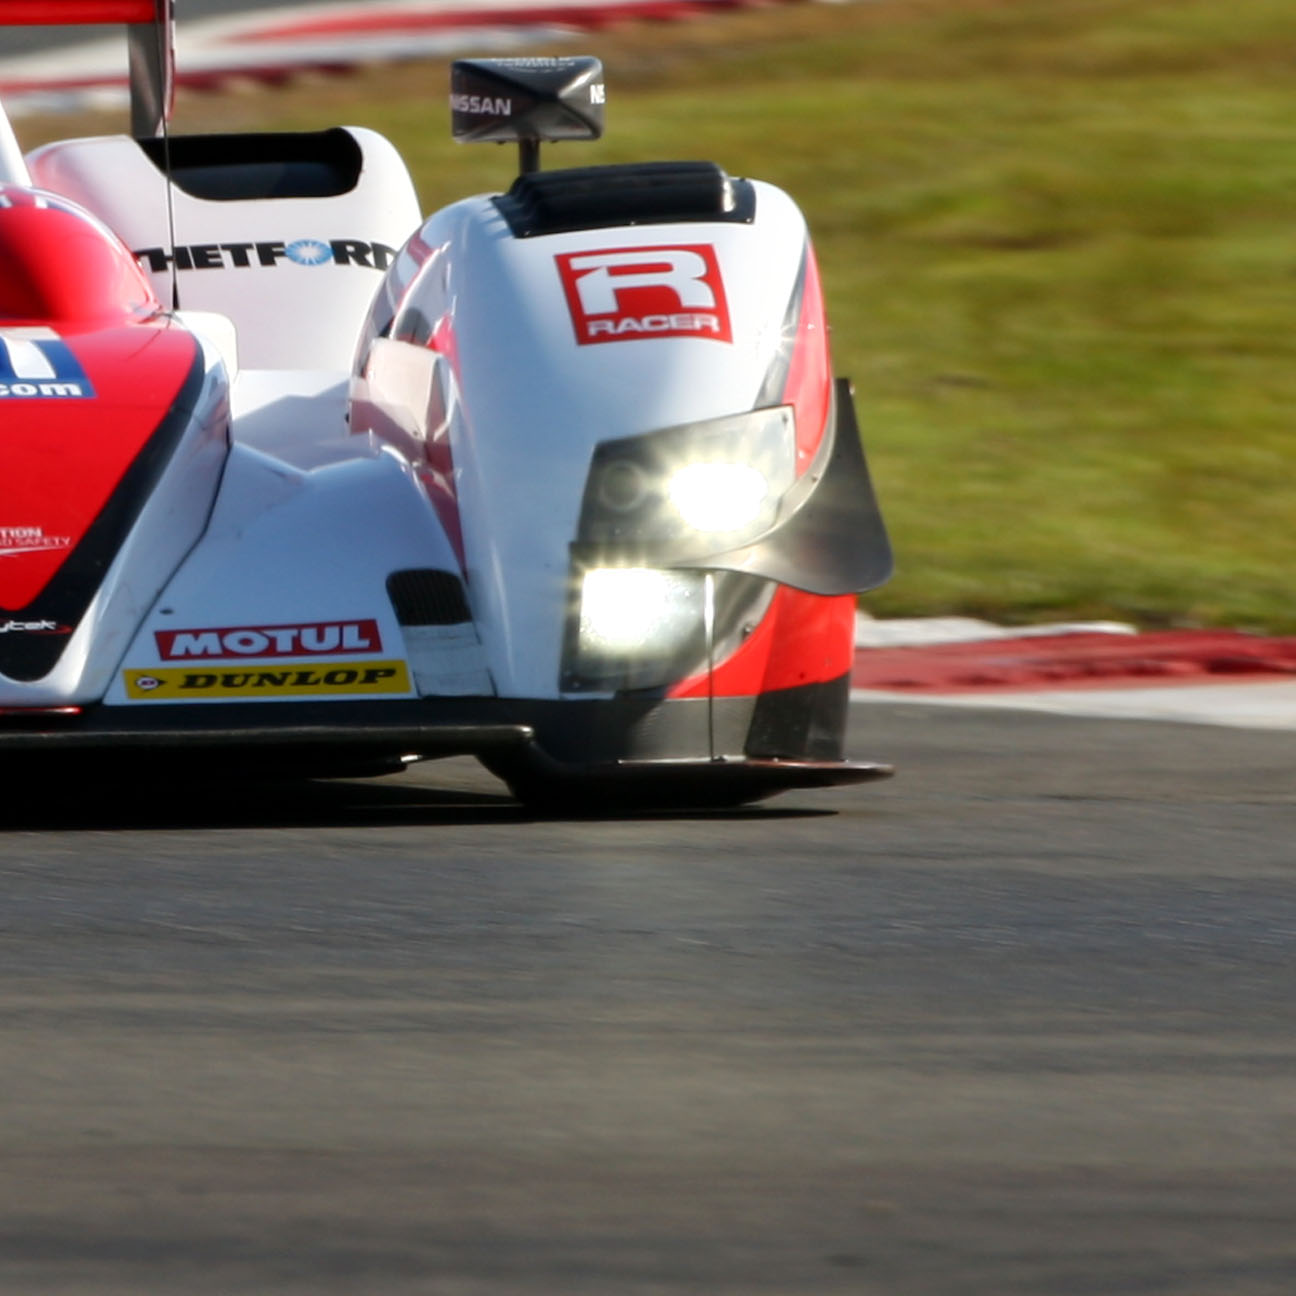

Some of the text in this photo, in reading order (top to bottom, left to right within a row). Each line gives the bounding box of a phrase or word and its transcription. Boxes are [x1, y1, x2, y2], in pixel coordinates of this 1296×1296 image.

[569, 250, 716, 315] R
[586, 312, 721, 337] RACER
[15, 536, 71, 546] SAFETY
[168, 624, 371, 655] MOTUL
[178, 668, 397, 689] DUNLOP
